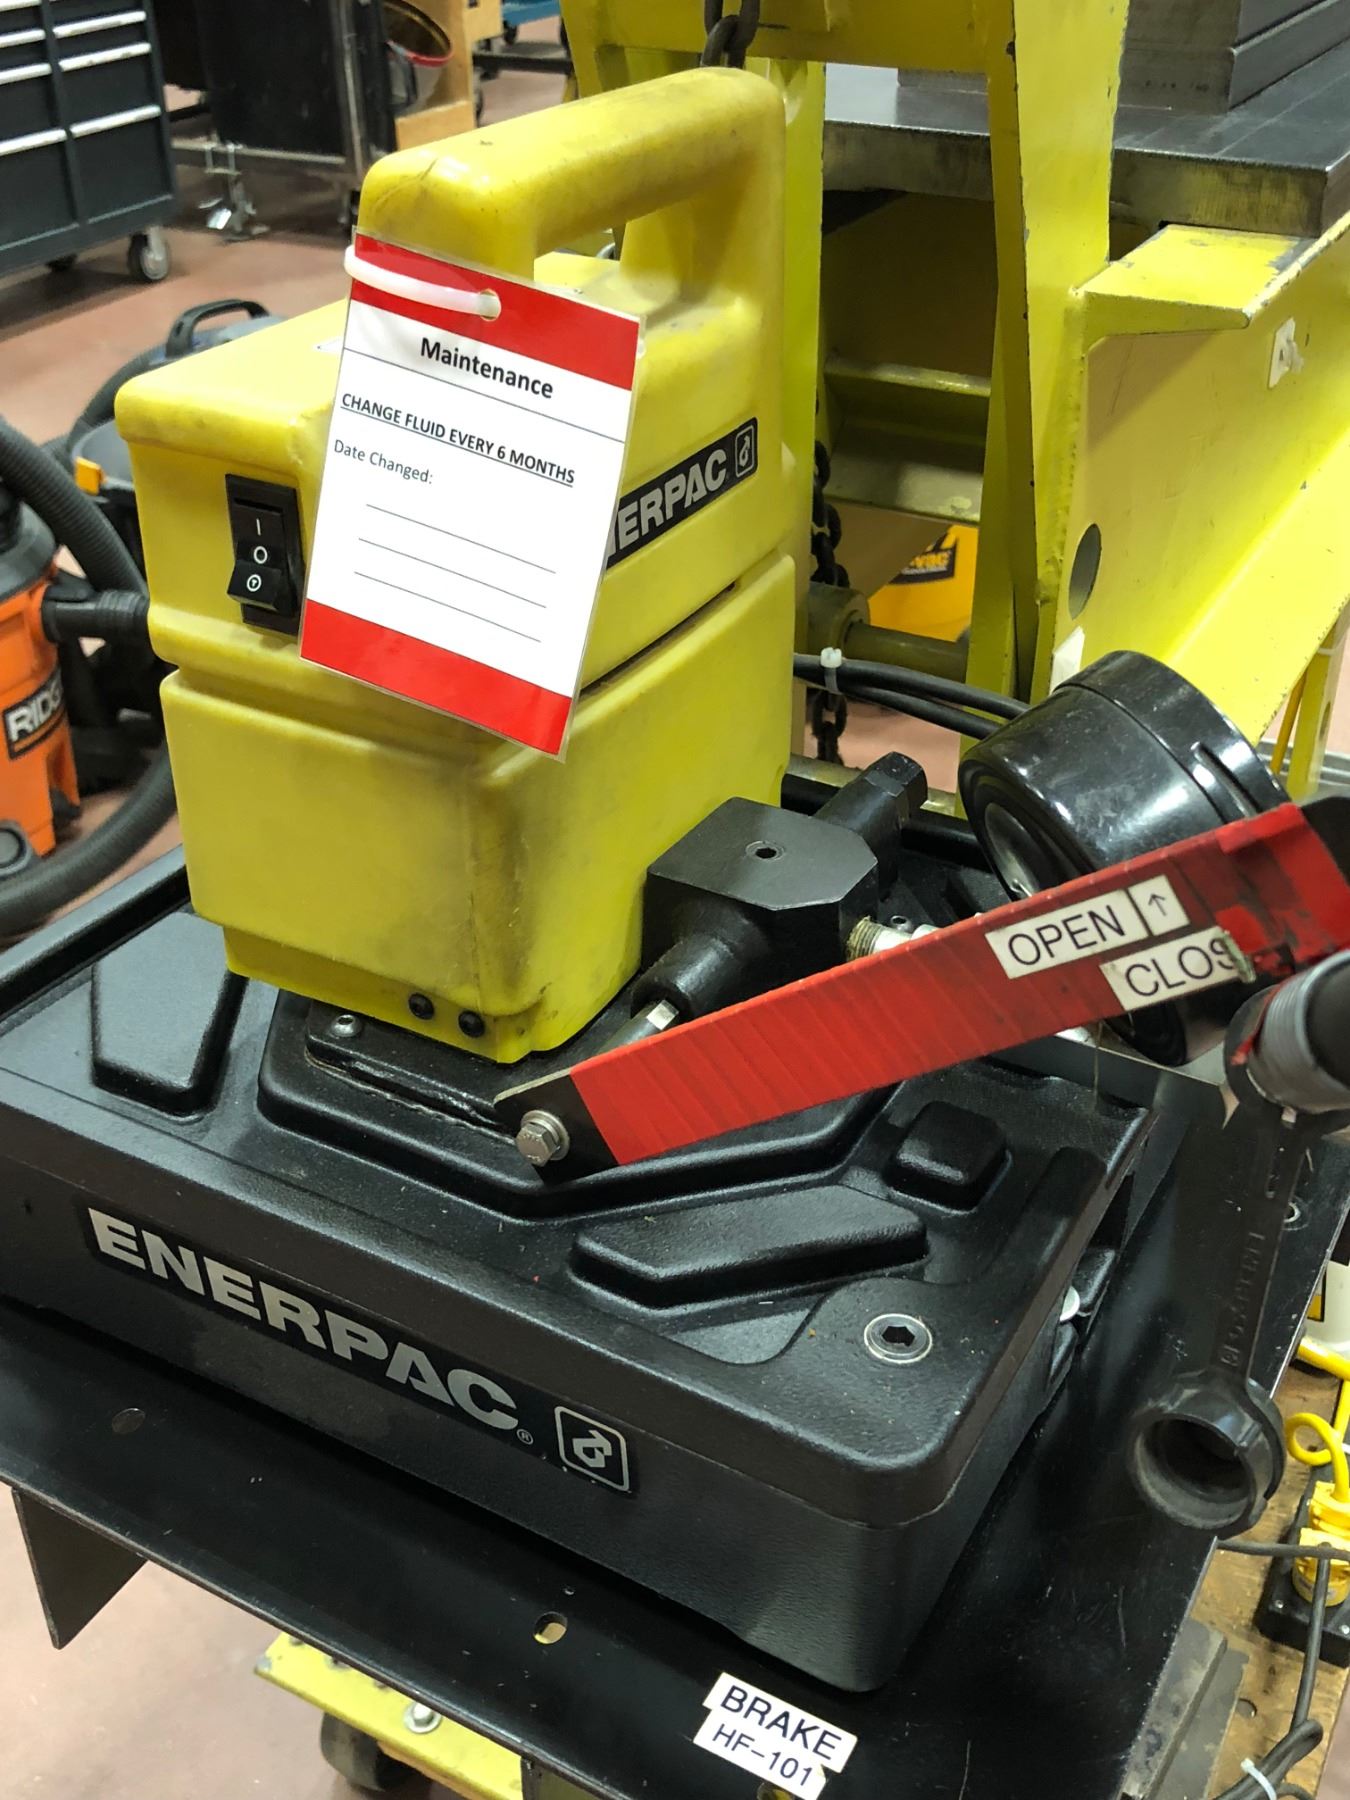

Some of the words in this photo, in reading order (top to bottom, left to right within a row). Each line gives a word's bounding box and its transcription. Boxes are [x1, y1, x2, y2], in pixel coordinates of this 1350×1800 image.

[420, 337, 553, 398] Maintenance
[334, 439, 366, 462] Date
[369, 451, 433, 484] Changed:
[342, 393, 402, 424] CHANGE
[405, 413, 446, 438] FLUID
[449, 428, 494, 455] EVERY
[497, 445, 506, 460] 6
[509, 449, 575, 484] MONTHS
[1008, 904, 1125, 966] OPEN
[88, 1206, 519, 1431] ENERPAC
[720, 1684, 842, 1761] BRAKE
[712, 1723, 813, 1787] HF-101
